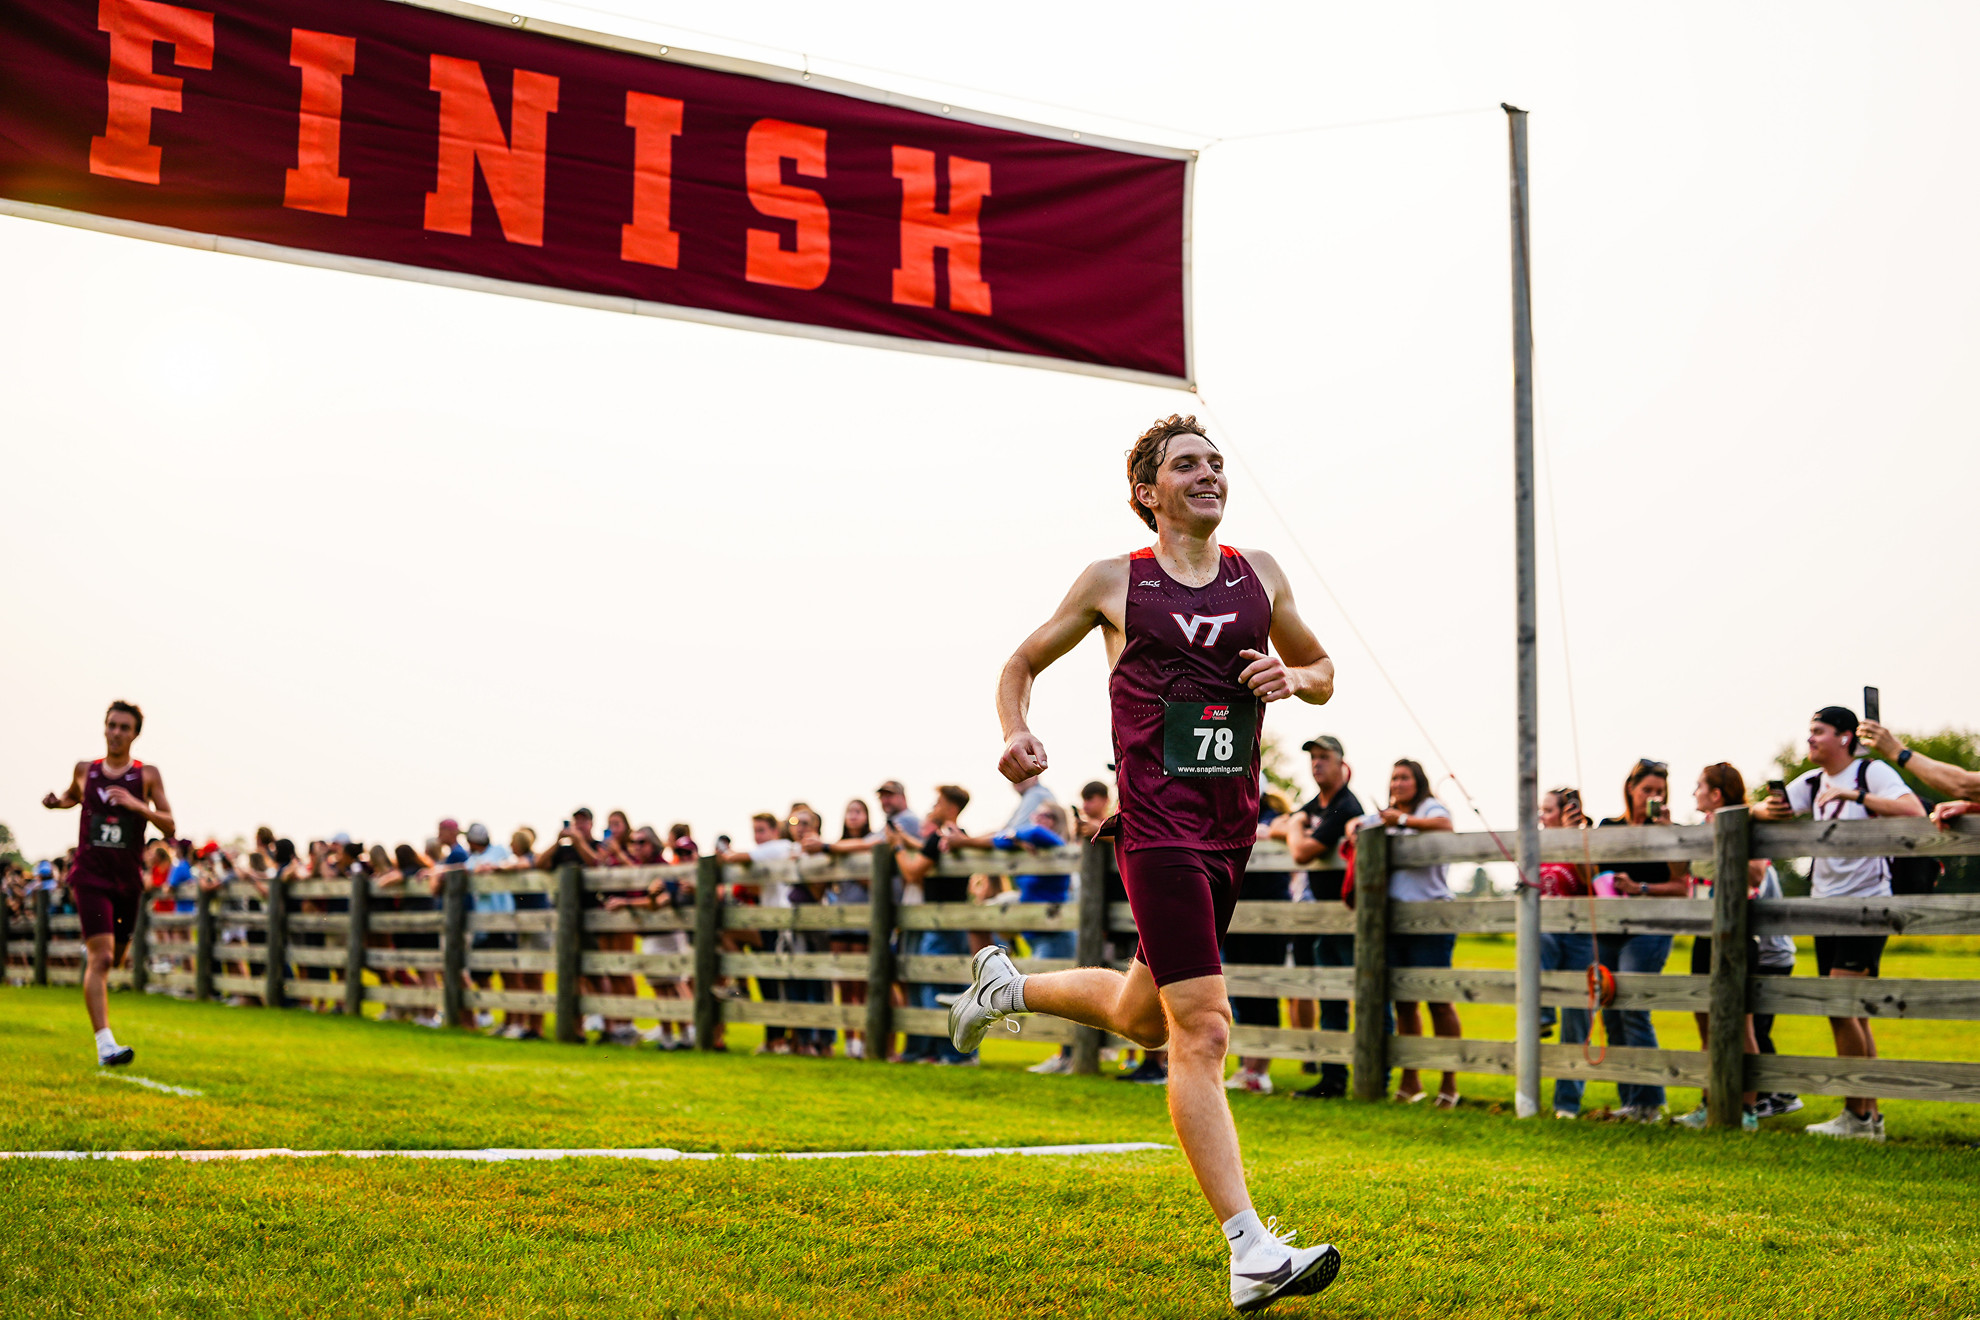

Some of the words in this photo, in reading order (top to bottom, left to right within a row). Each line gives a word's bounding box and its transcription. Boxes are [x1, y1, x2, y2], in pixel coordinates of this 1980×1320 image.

[89, 0, 992, 316] FINISH
[1169, 611, 1239, 648] VT
[1201, 705, 1229, 720] SNAP
[1193, 727, 1234, 761] 78
[1177, 765, 1243, 774] www.snaptiming.com
[100, 824, 121, 843] 79
